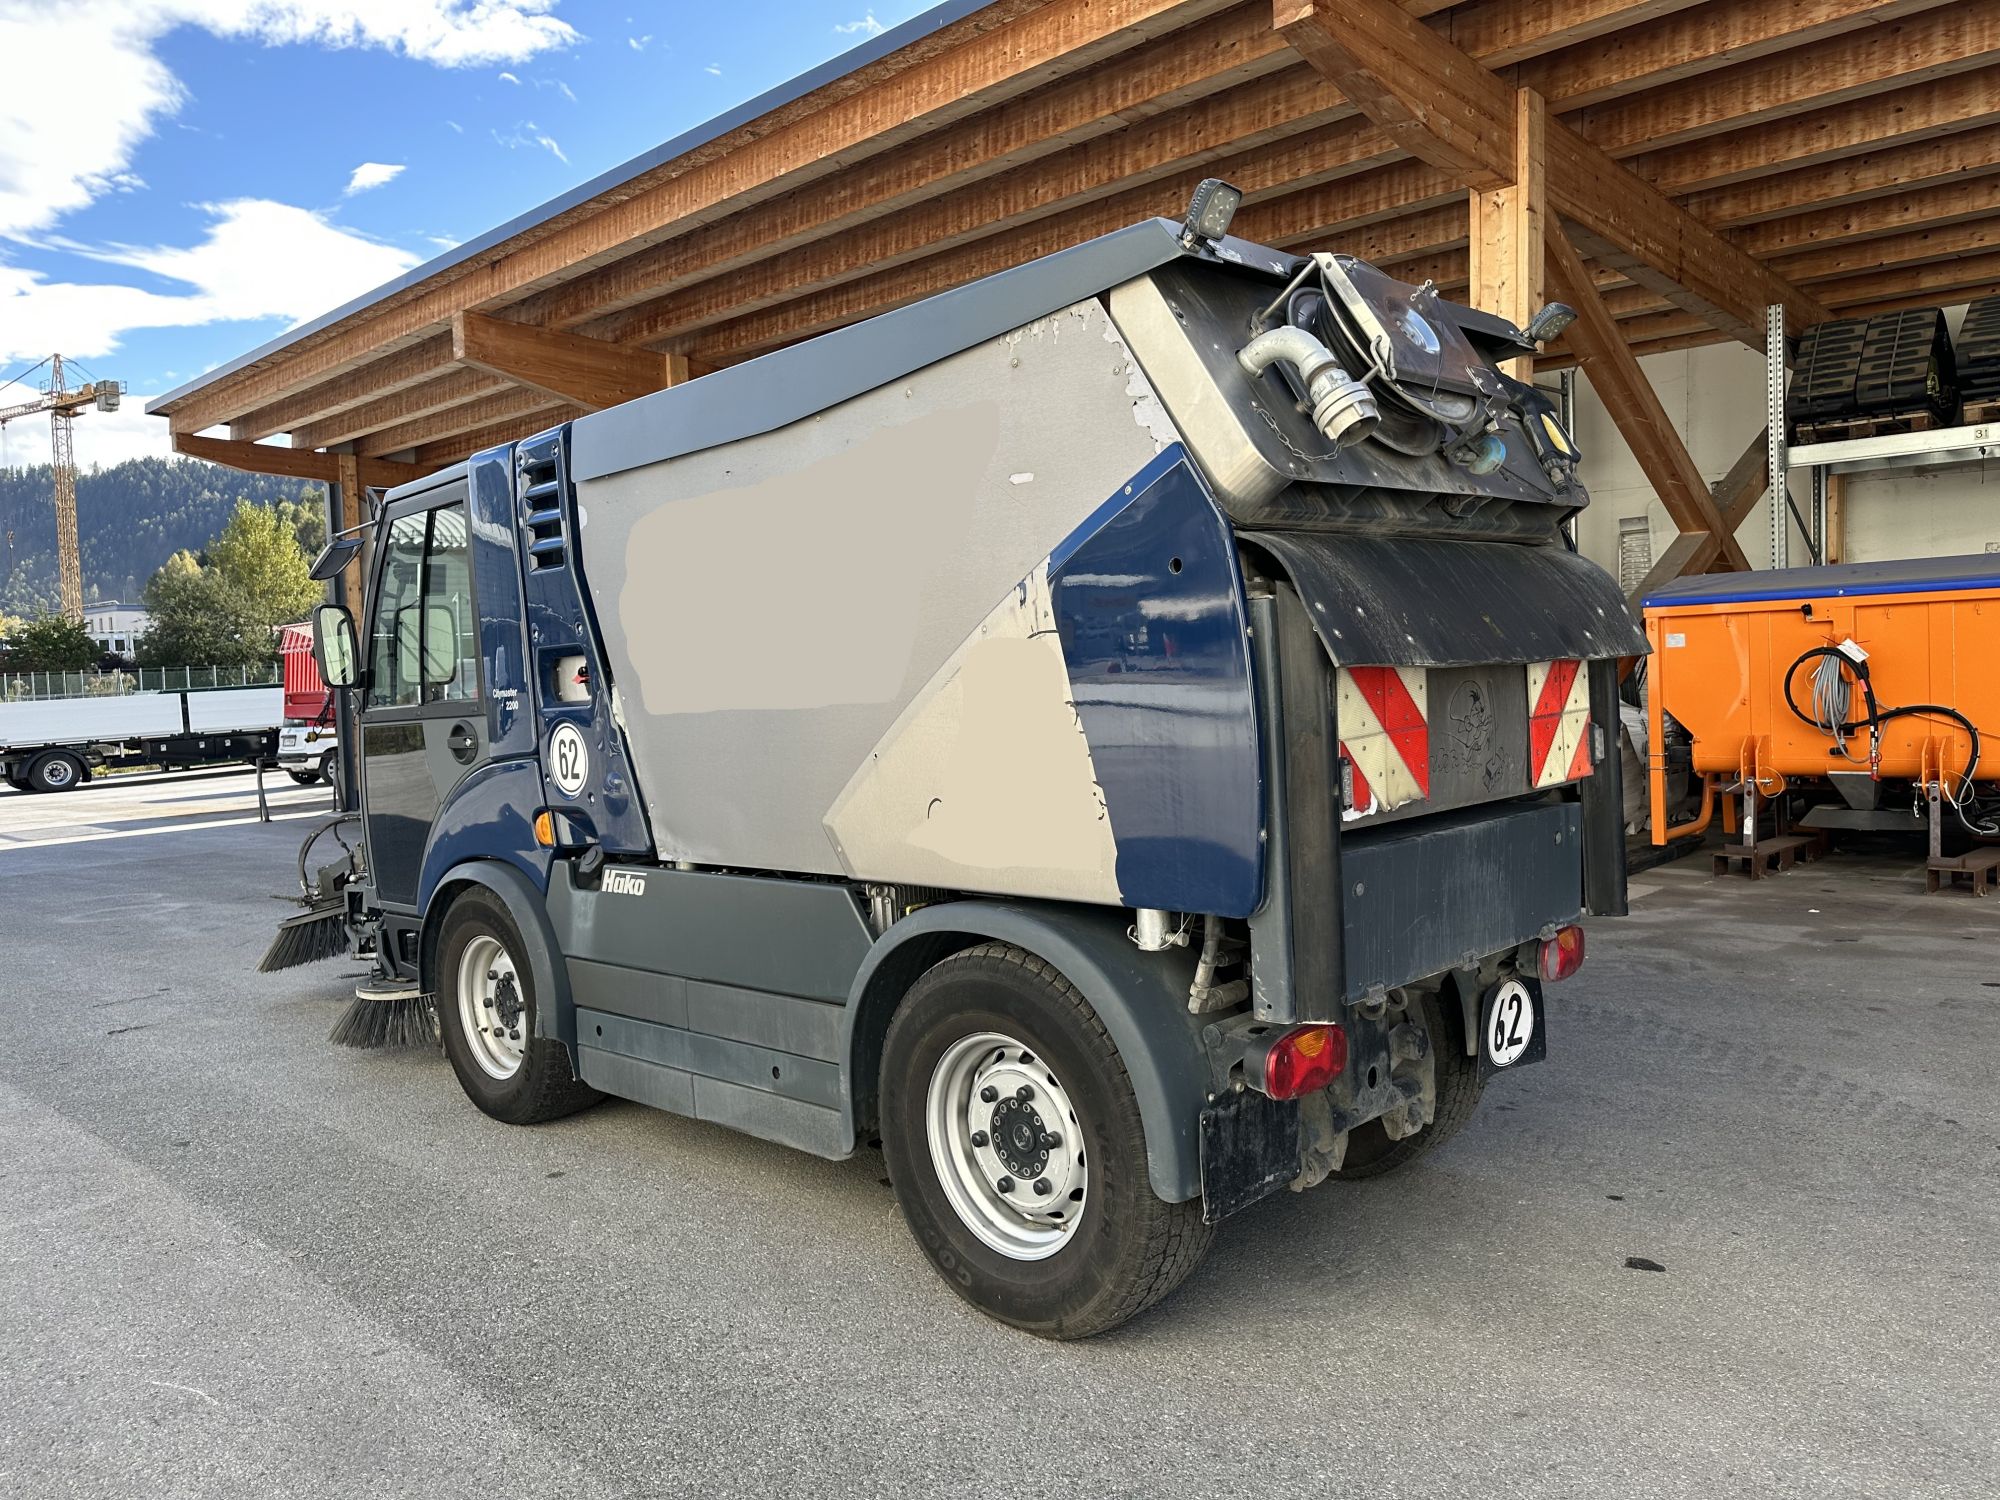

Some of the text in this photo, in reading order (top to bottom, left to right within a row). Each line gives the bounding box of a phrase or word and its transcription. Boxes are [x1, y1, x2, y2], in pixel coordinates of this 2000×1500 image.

[492, 687, 518, 700] Citymaster
[505, 700, 519, 711] 2200
[558, 738, 580, 780] 62
[601, 869, 648, 896] Hako
[1494, 993, 1523, 1052] 62
